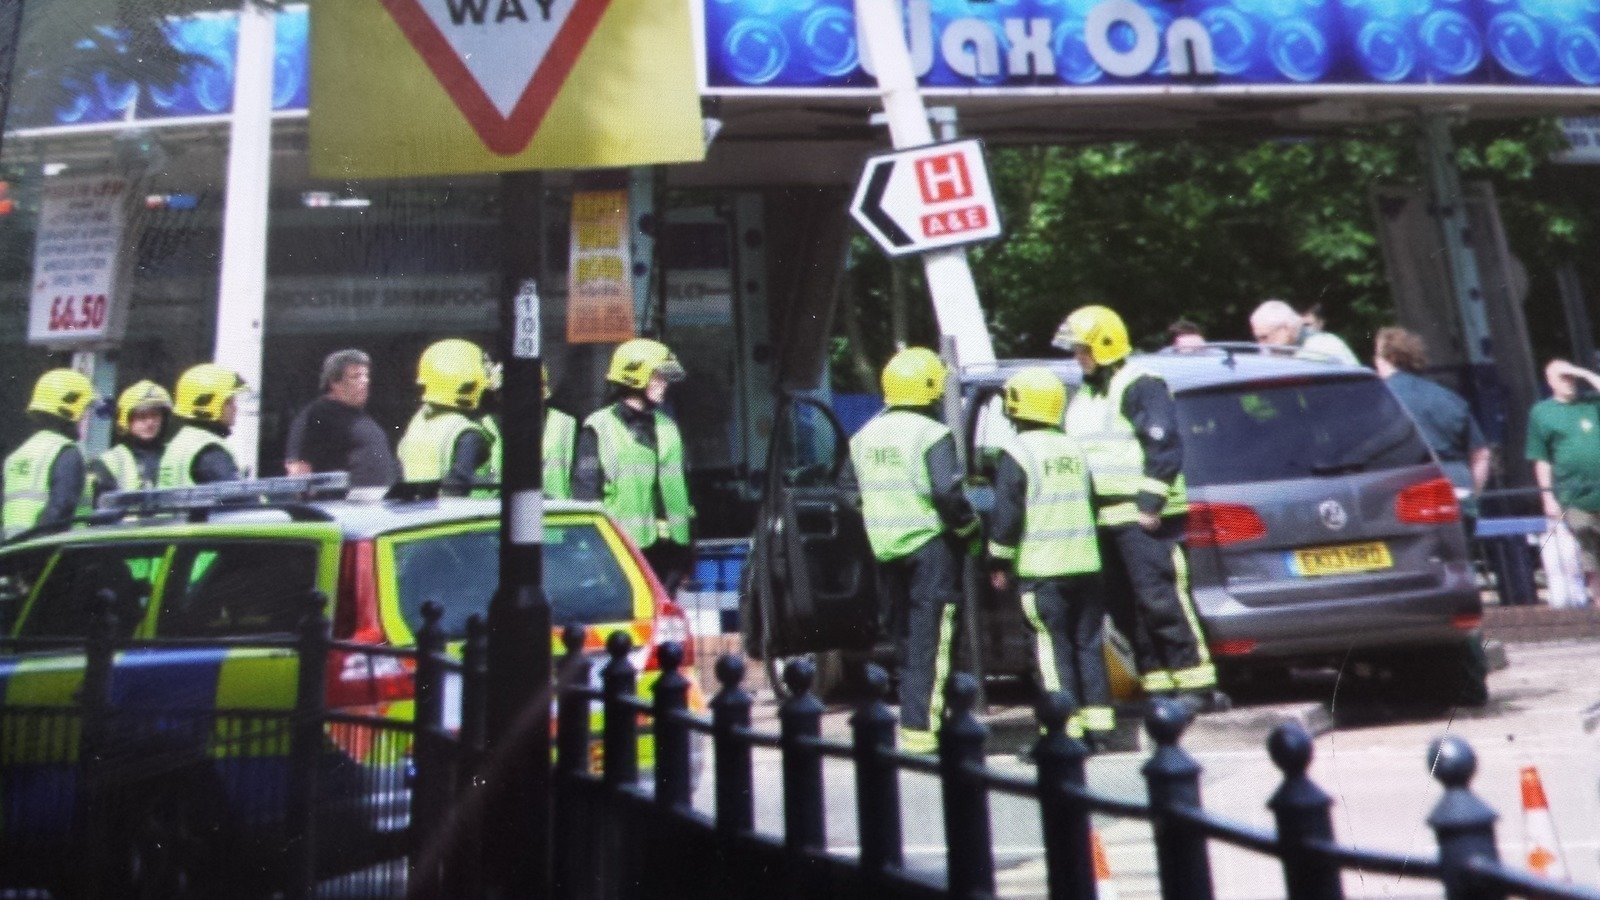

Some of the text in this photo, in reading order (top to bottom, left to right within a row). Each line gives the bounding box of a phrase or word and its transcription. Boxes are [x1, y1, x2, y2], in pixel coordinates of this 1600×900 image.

[1084, 0, 1215, 78] On
[923, 155, 965, 200] H
[927, 207, 982, 233] A&E
[48, 294, 107, 333] £6.50
